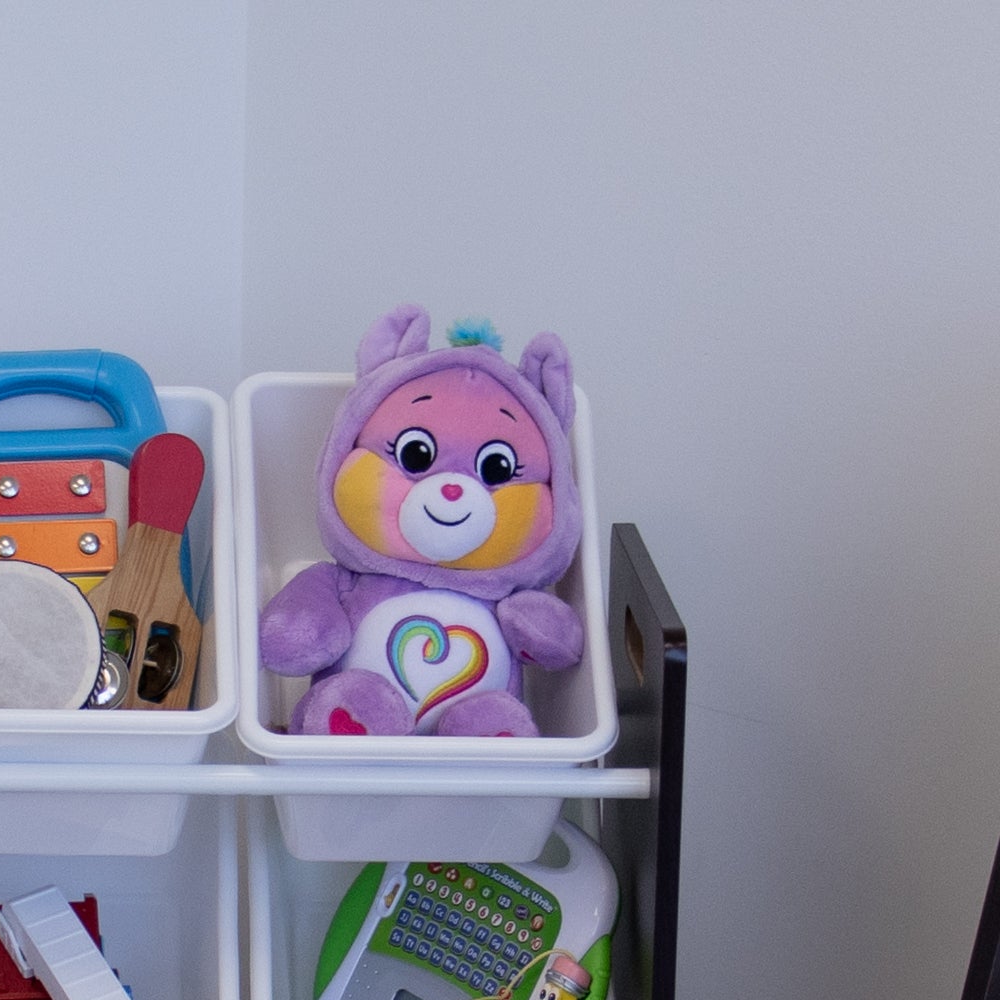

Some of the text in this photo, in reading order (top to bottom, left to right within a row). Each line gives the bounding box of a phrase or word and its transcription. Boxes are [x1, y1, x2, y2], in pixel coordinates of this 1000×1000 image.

[490, 868, 523, 893] Scribble
[521, 886, 531, 898] &
[530, 890, 554, 913] Write
[497, 895, 511, 908] 123
